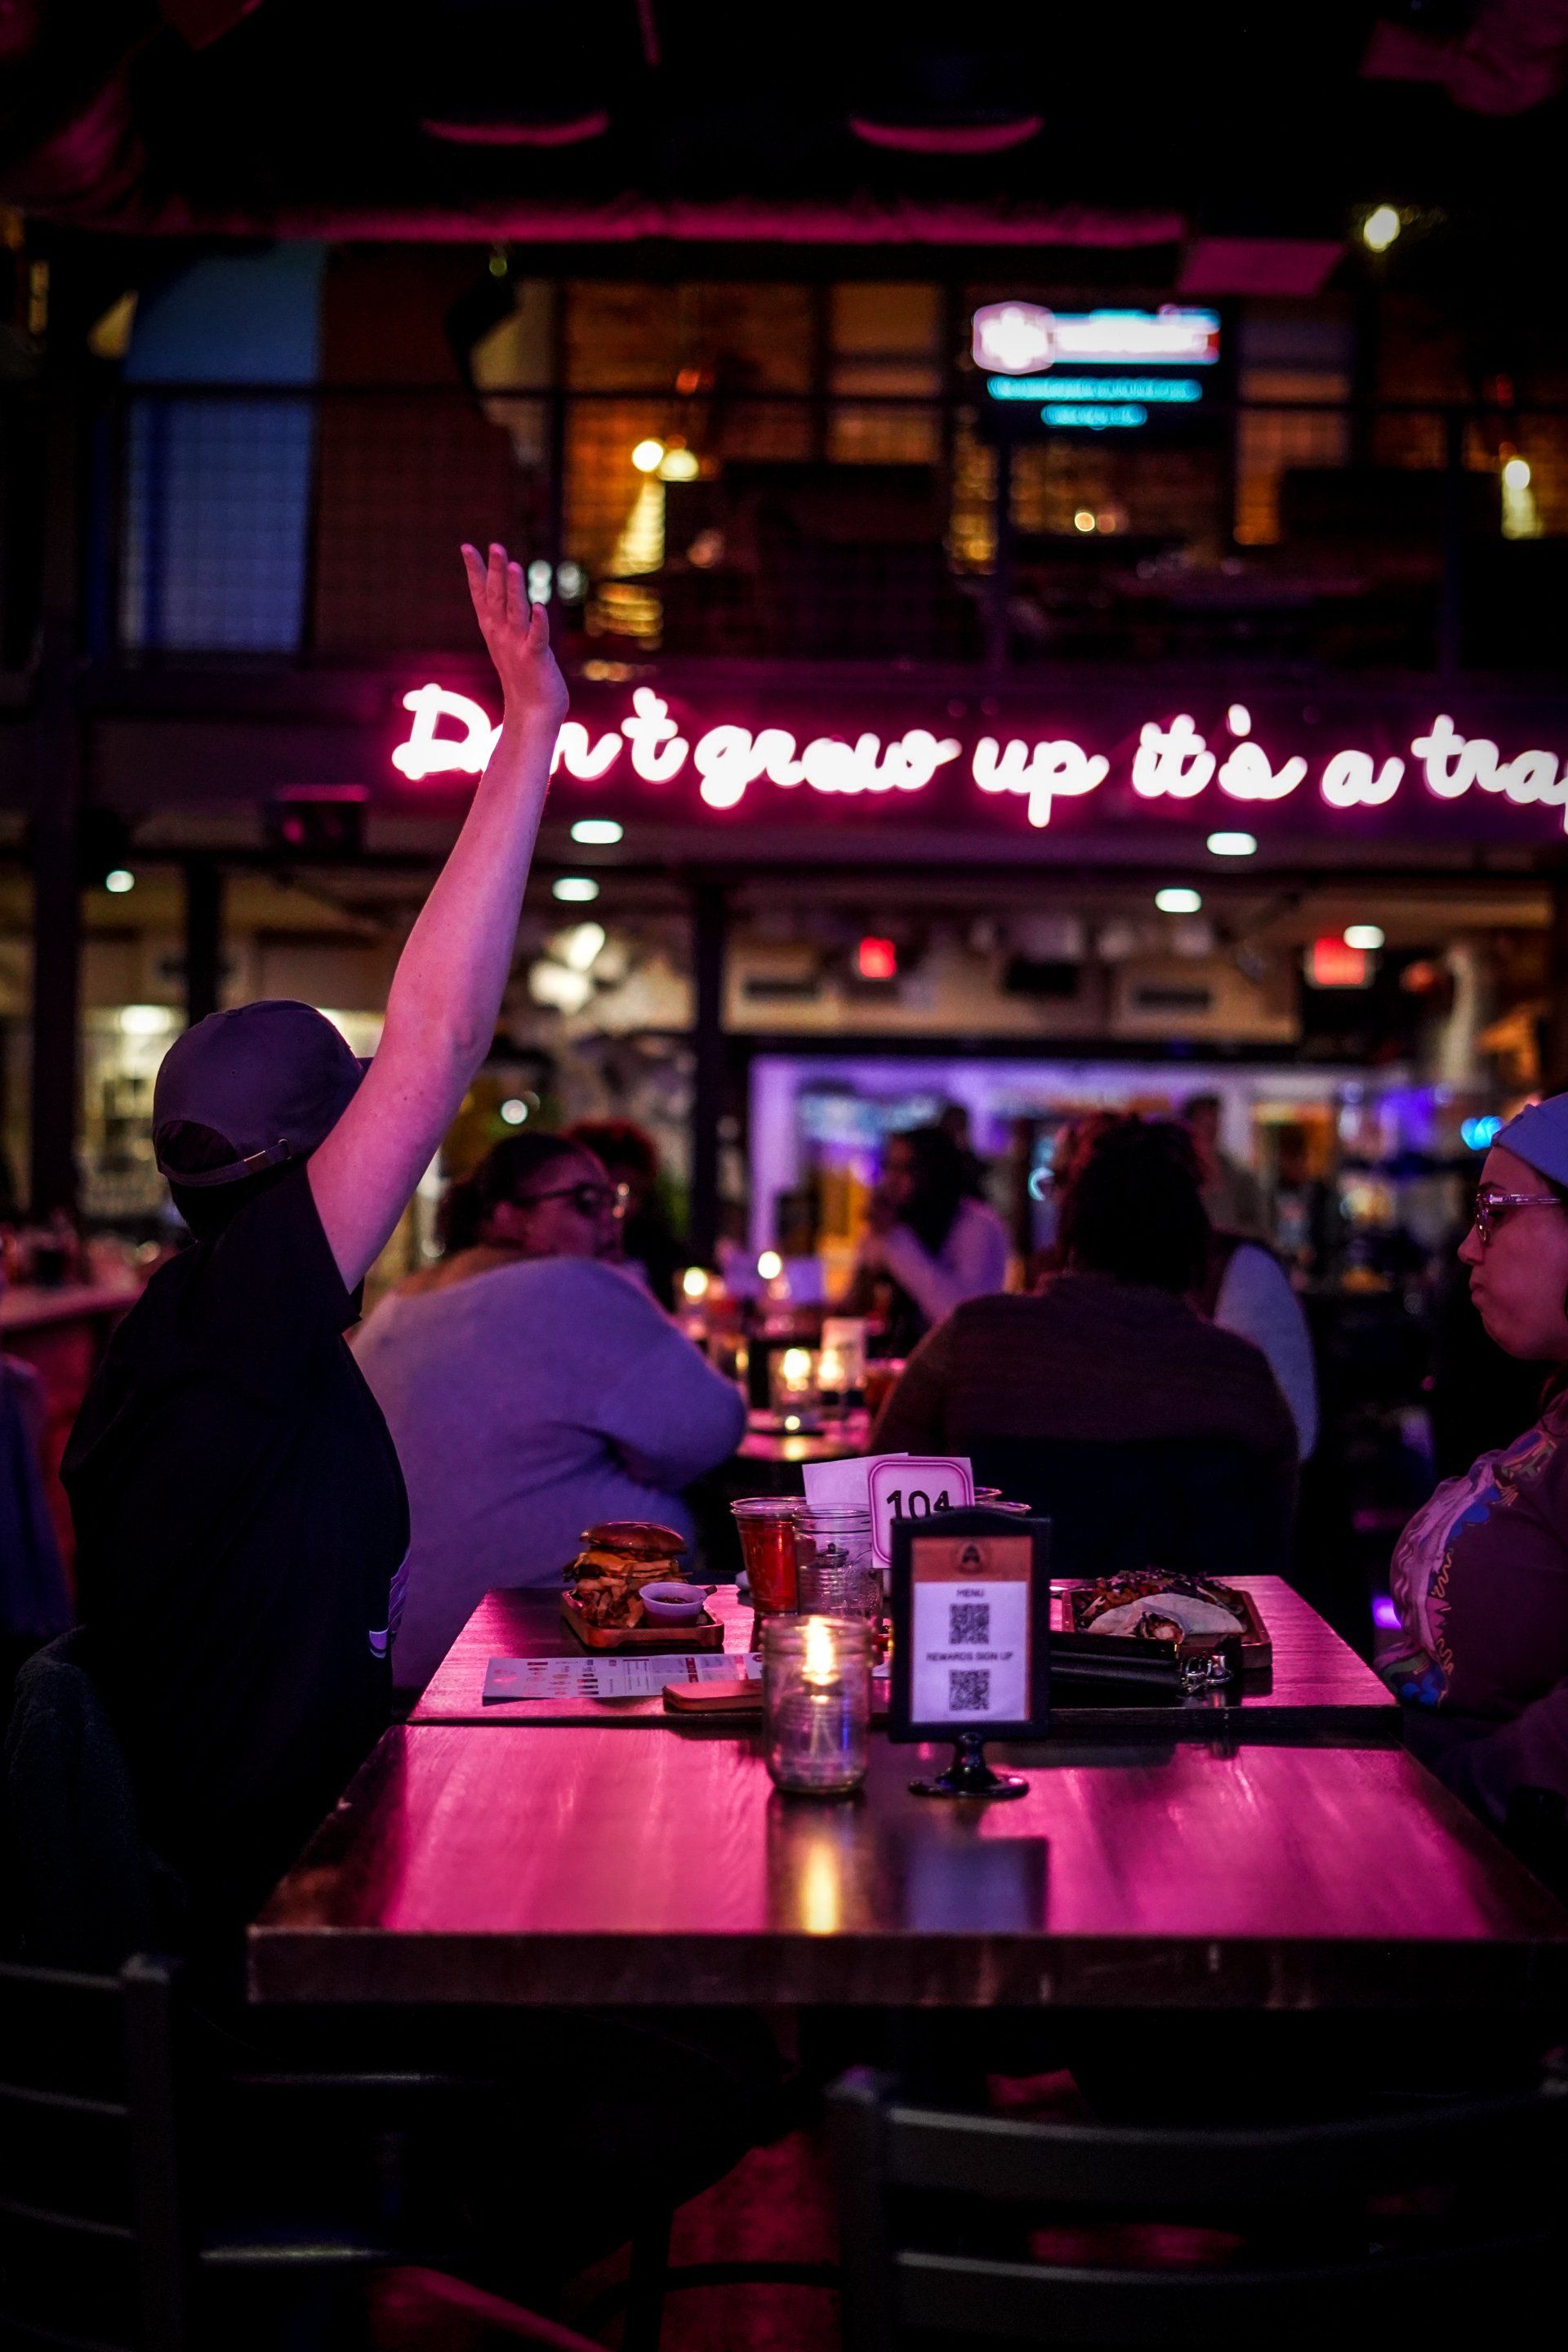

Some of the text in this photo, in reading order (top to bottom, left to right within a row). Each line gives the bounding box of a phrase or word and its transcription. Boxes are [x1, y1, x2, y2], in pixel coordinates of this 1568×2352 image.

[392, 683, 1568, 835] Dn't grow up it's a tra
[887, 1490, 954, 1519] 104
[956, 1588, 985, 1597] MENU
